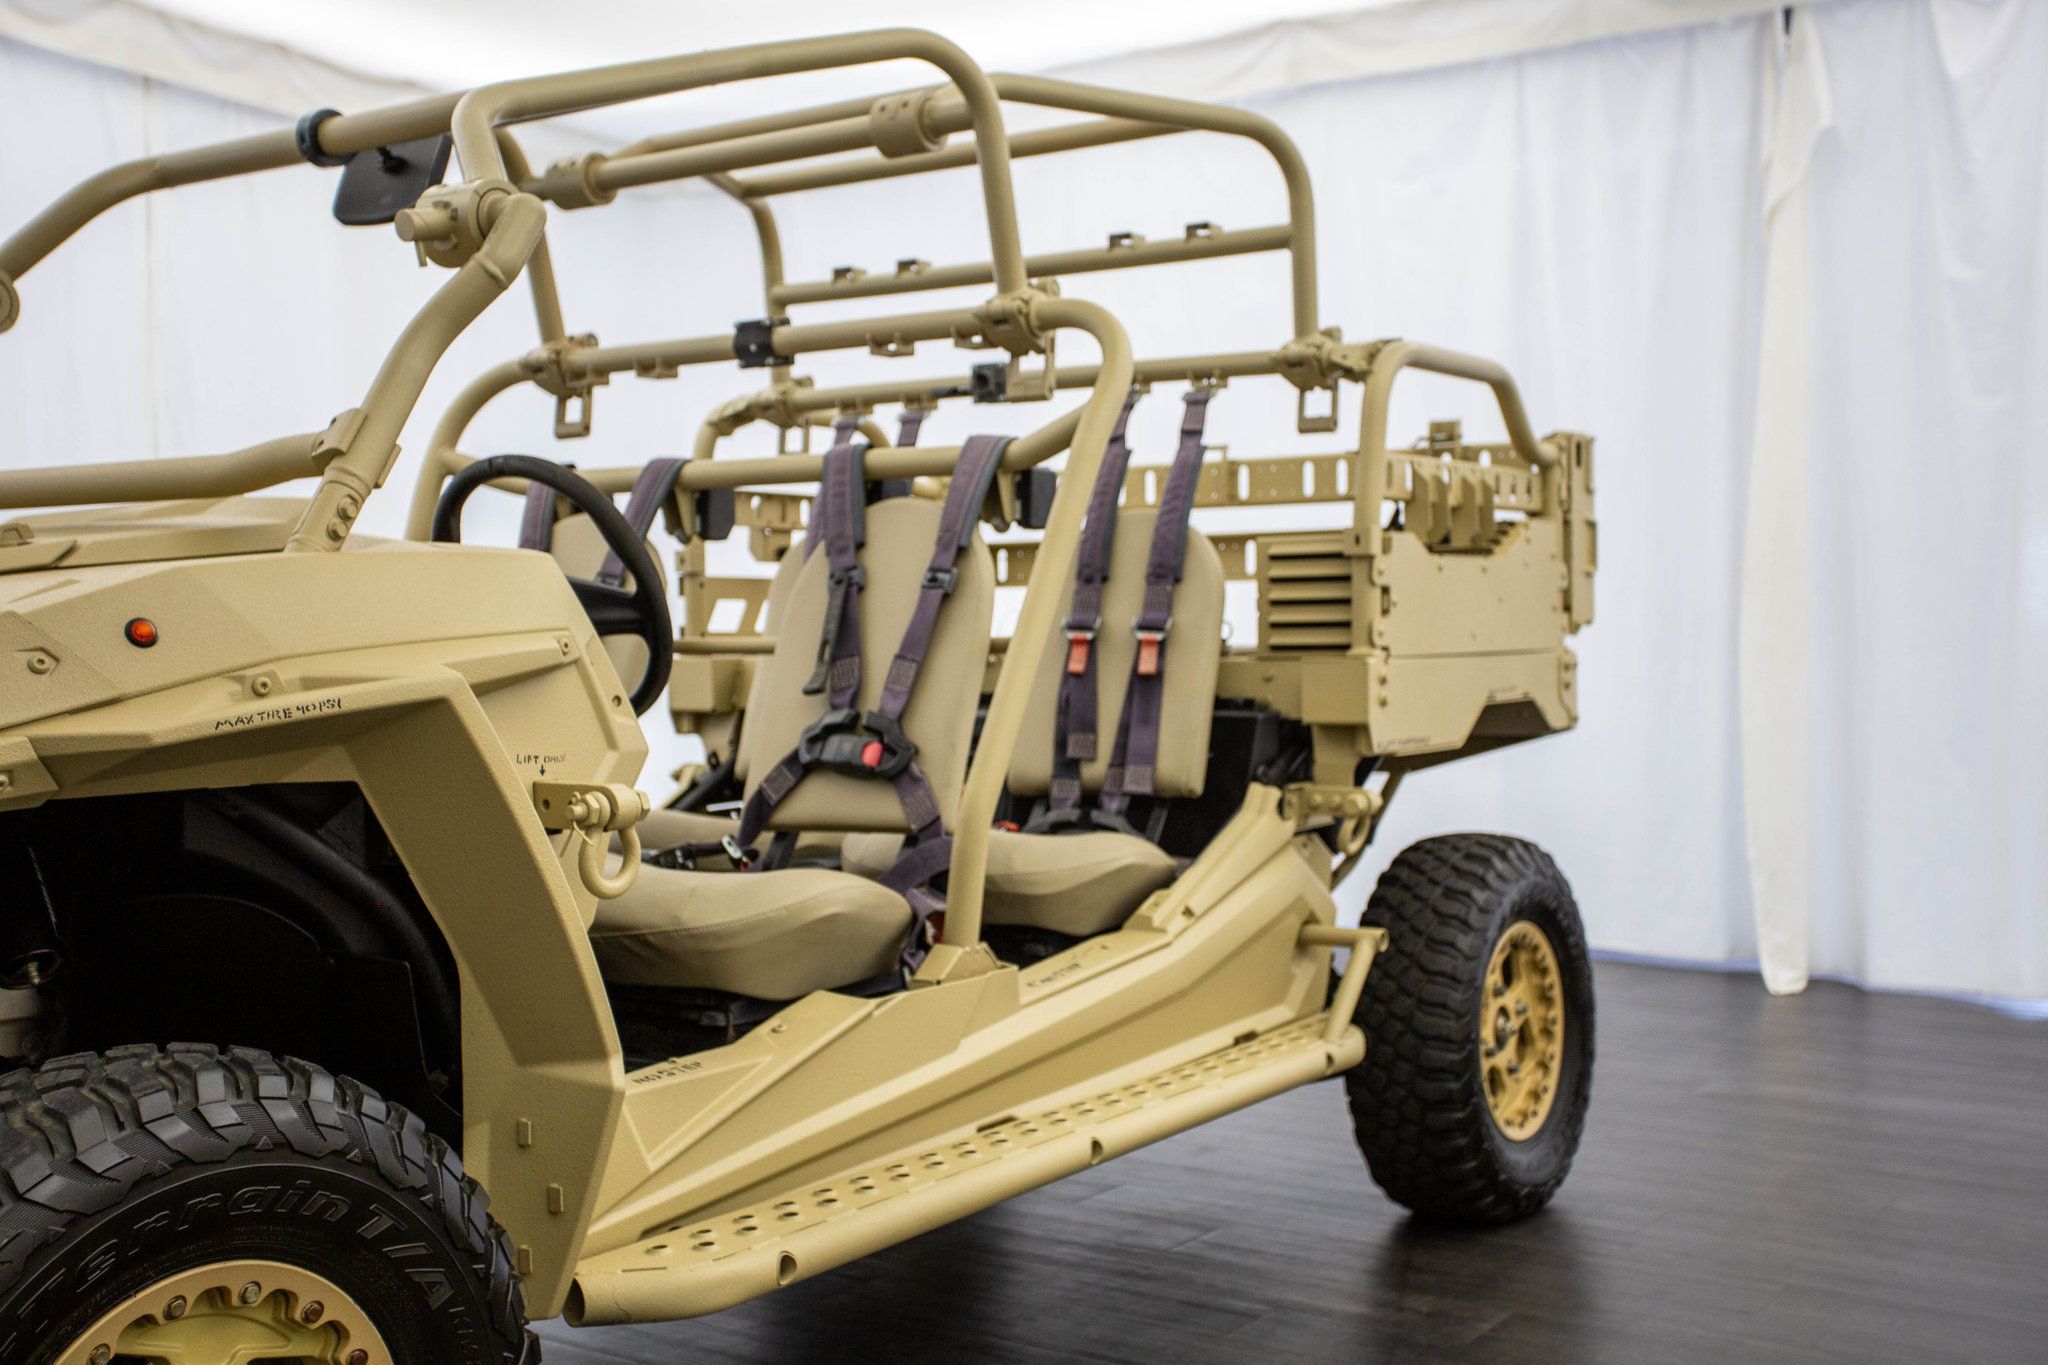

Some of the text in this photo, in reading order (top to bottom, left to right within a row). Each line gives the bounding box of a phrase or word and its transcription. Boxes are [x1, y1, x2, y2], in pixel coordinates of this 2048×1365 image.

[215, 714, 254, 731] MAX
[257, 707, 292, 722] TIRE
[516, 753, 566, 765] LIFT ONLY
